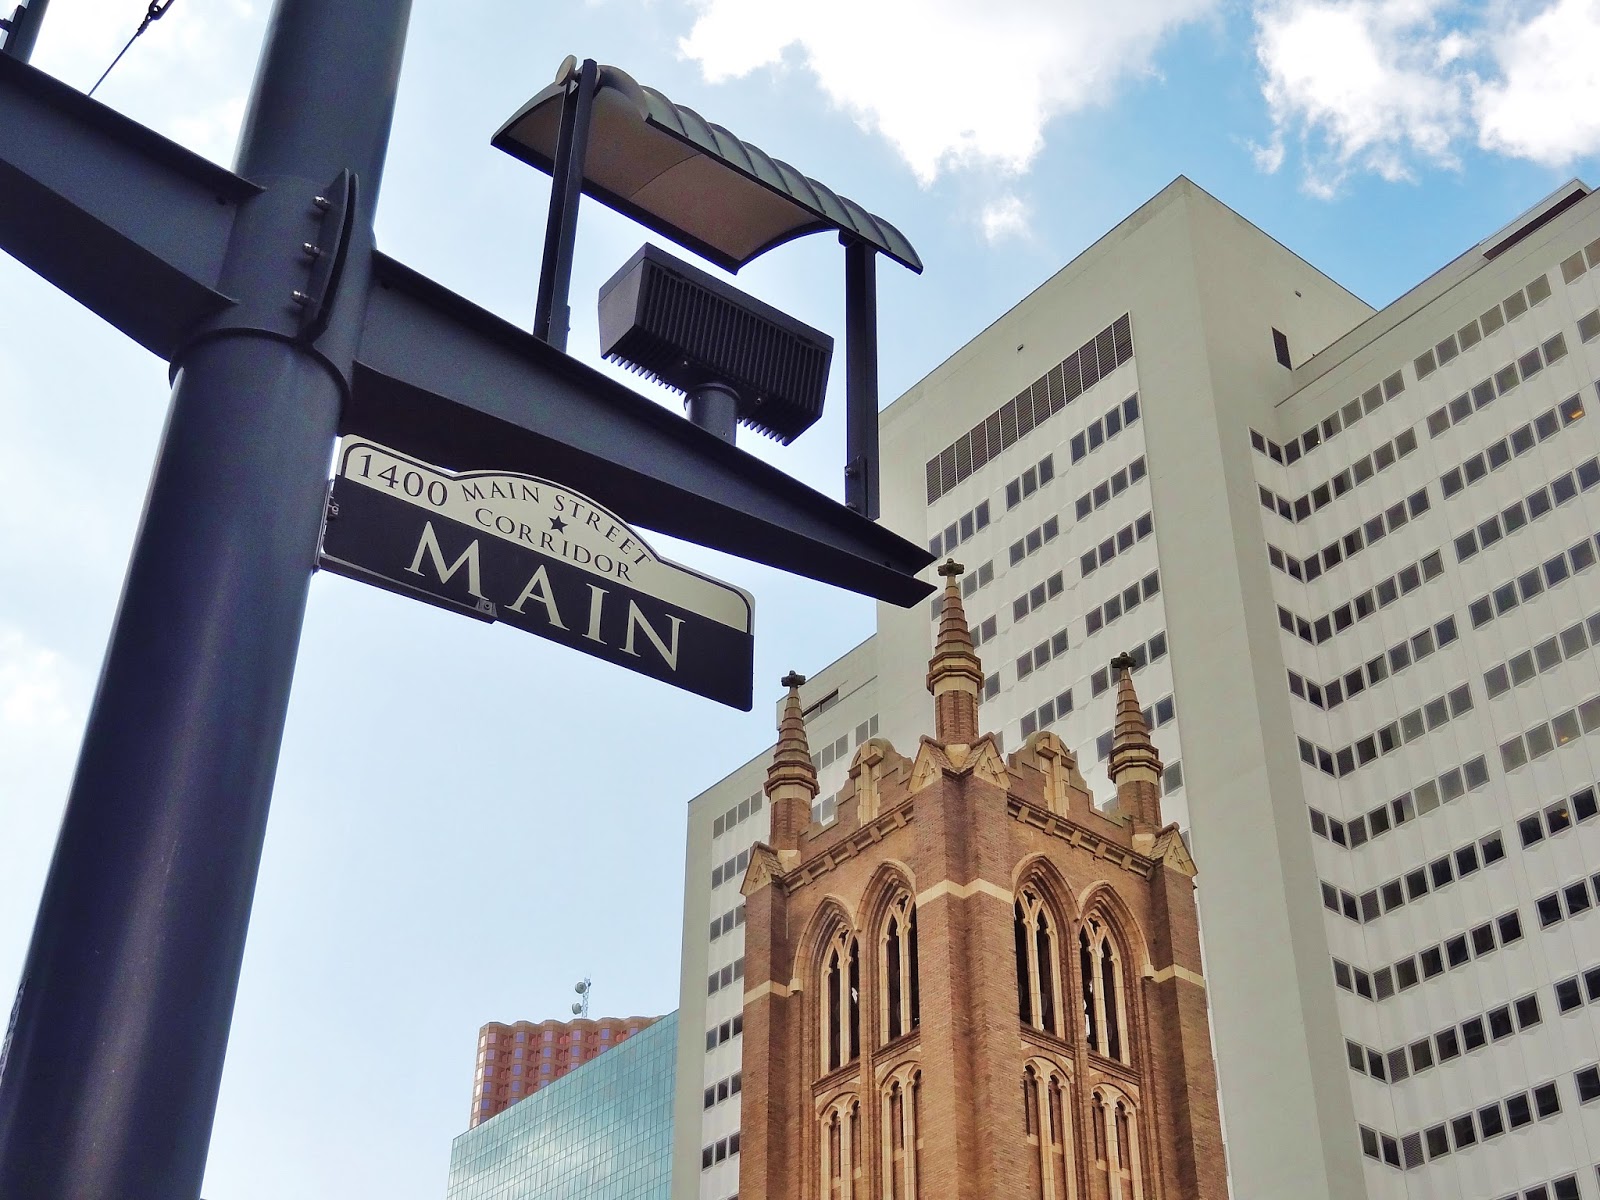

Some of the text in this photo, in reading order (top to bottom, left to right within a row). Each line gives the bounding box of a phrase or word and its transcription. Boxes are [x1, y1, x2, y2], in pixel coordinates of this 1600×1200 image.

[358, 454, 447, 508] 1400
[461, 480, 652, 566] MAIN STREET
[475, 507, 634, 583] CORRIDOR
[404, 520, 686, 672] MAIN
